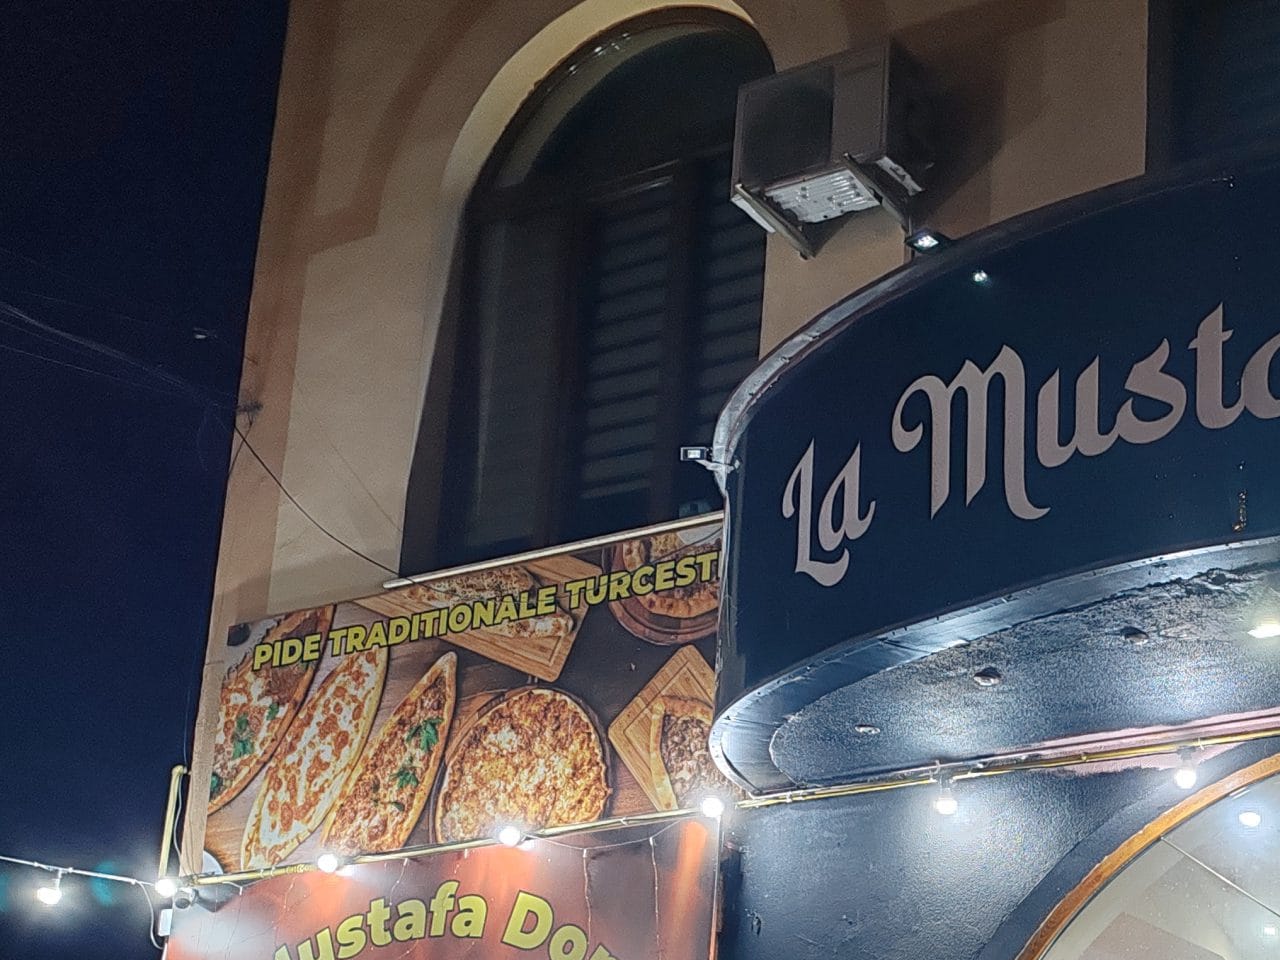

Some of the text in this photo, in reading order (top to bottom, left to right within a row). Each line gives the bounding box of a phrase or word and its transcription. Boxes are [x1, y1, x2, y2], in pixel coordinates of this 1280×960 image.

[782, 437, 875, 588] La
[252, 551, 720, 671] PIDE TRADITIONALE TURCEST
